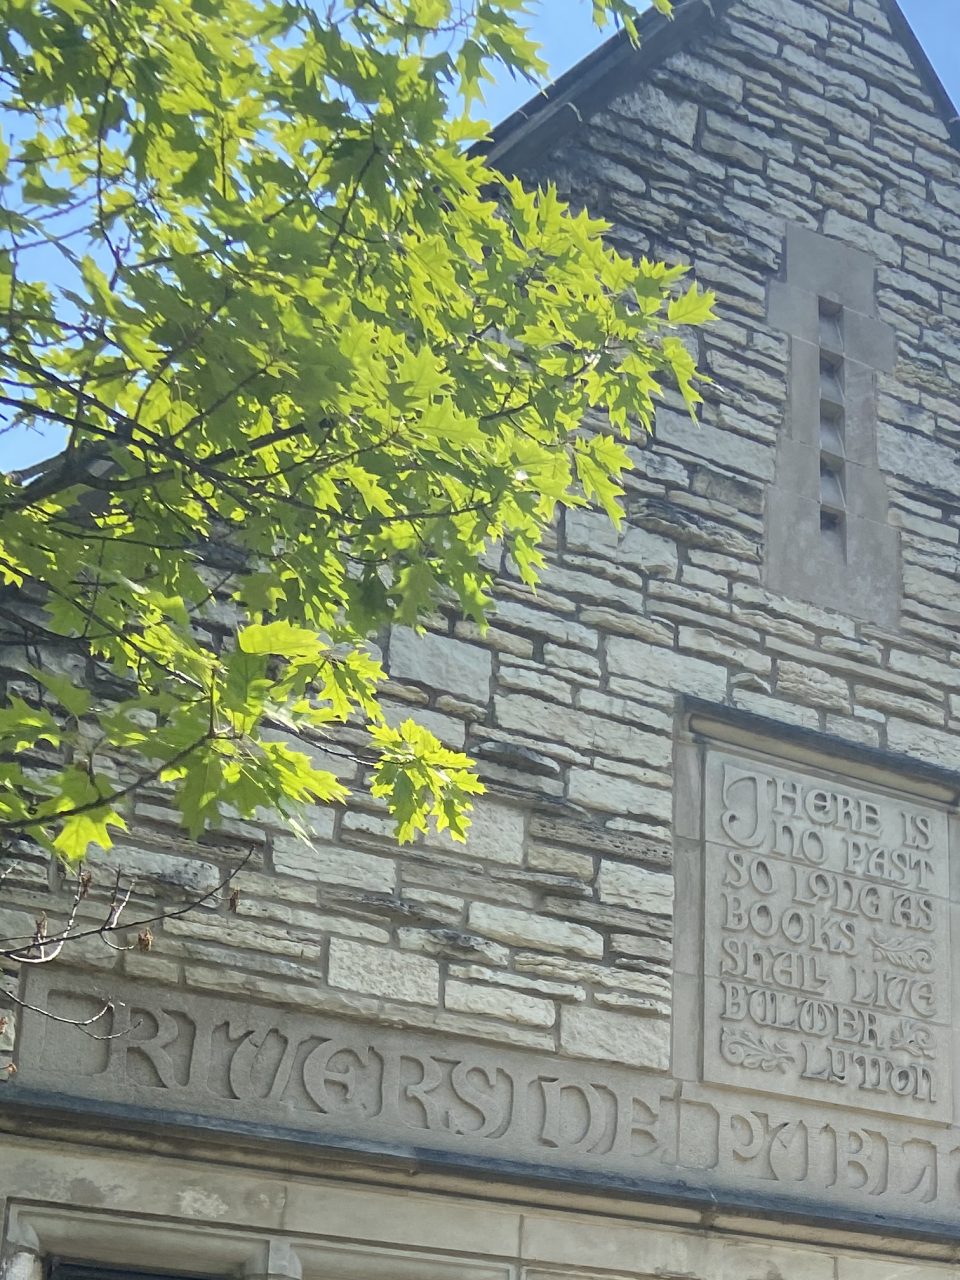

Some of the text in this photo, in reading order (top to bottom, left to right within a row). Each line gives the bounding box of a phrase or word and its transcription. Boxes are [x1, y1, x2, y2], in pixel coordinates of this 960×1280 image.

[721, 763, 934, 851] THERE IS
[773, 819, 935, 891] NO PAST
[721, 892, 858, 957] BOOKS
[724, 852, 936, 932] SO LONG AS
[720, 979, 886, 1050] BULWER
[850, 966, 937, 1018] LIVE
[112, 1003, 664, 1158] RIVERSIDE
[801, 1041, 937, 1103] LYTTON
